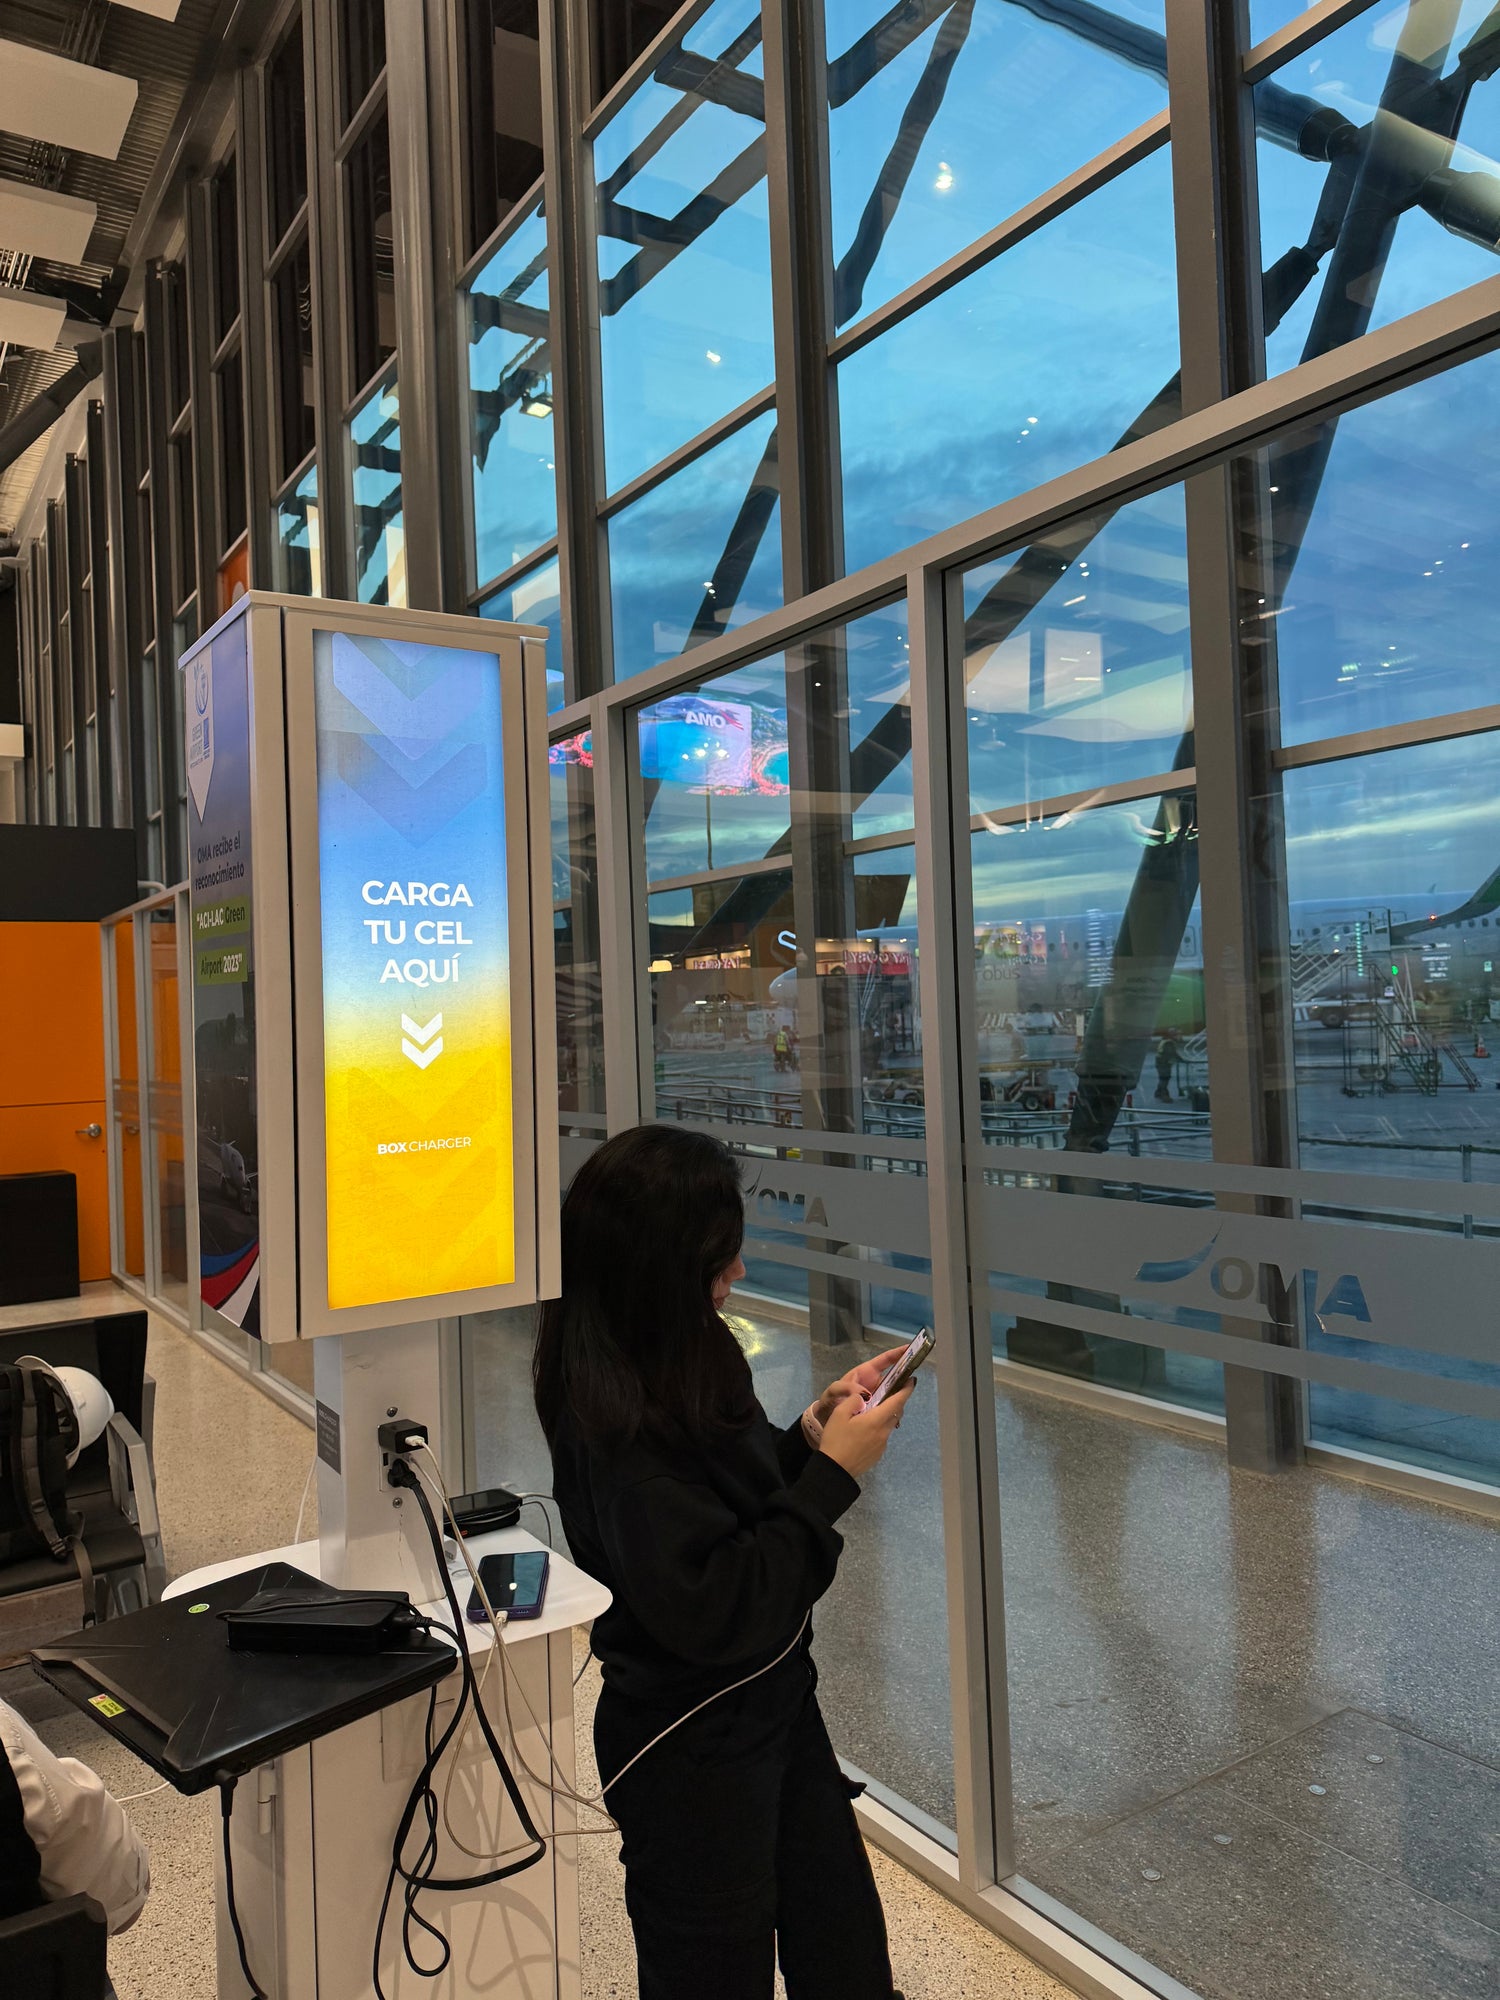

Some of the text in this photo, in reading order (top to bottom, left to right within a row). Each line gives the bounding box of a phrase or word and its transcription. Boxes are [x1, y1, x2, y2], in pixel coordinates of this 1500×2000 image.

[212, 836, 233, 859] recibe
[233, 830, 241, 850] el
[195, 861, 245, 891] reconocimiento
[361, 879, 474, 908] CARGA
[225, 906, 246, 924] Green
[363, 919, 474, 946] TU CEL
[200, 956, 223, 979] Airport
[379, 952, 461, 989] AQUÍ
[377, 1136, 472, 1155] BOX CHARGER
[756, 1187, 829, 1228] OMA
[1210, 1256, 1373, 1326] OMA
